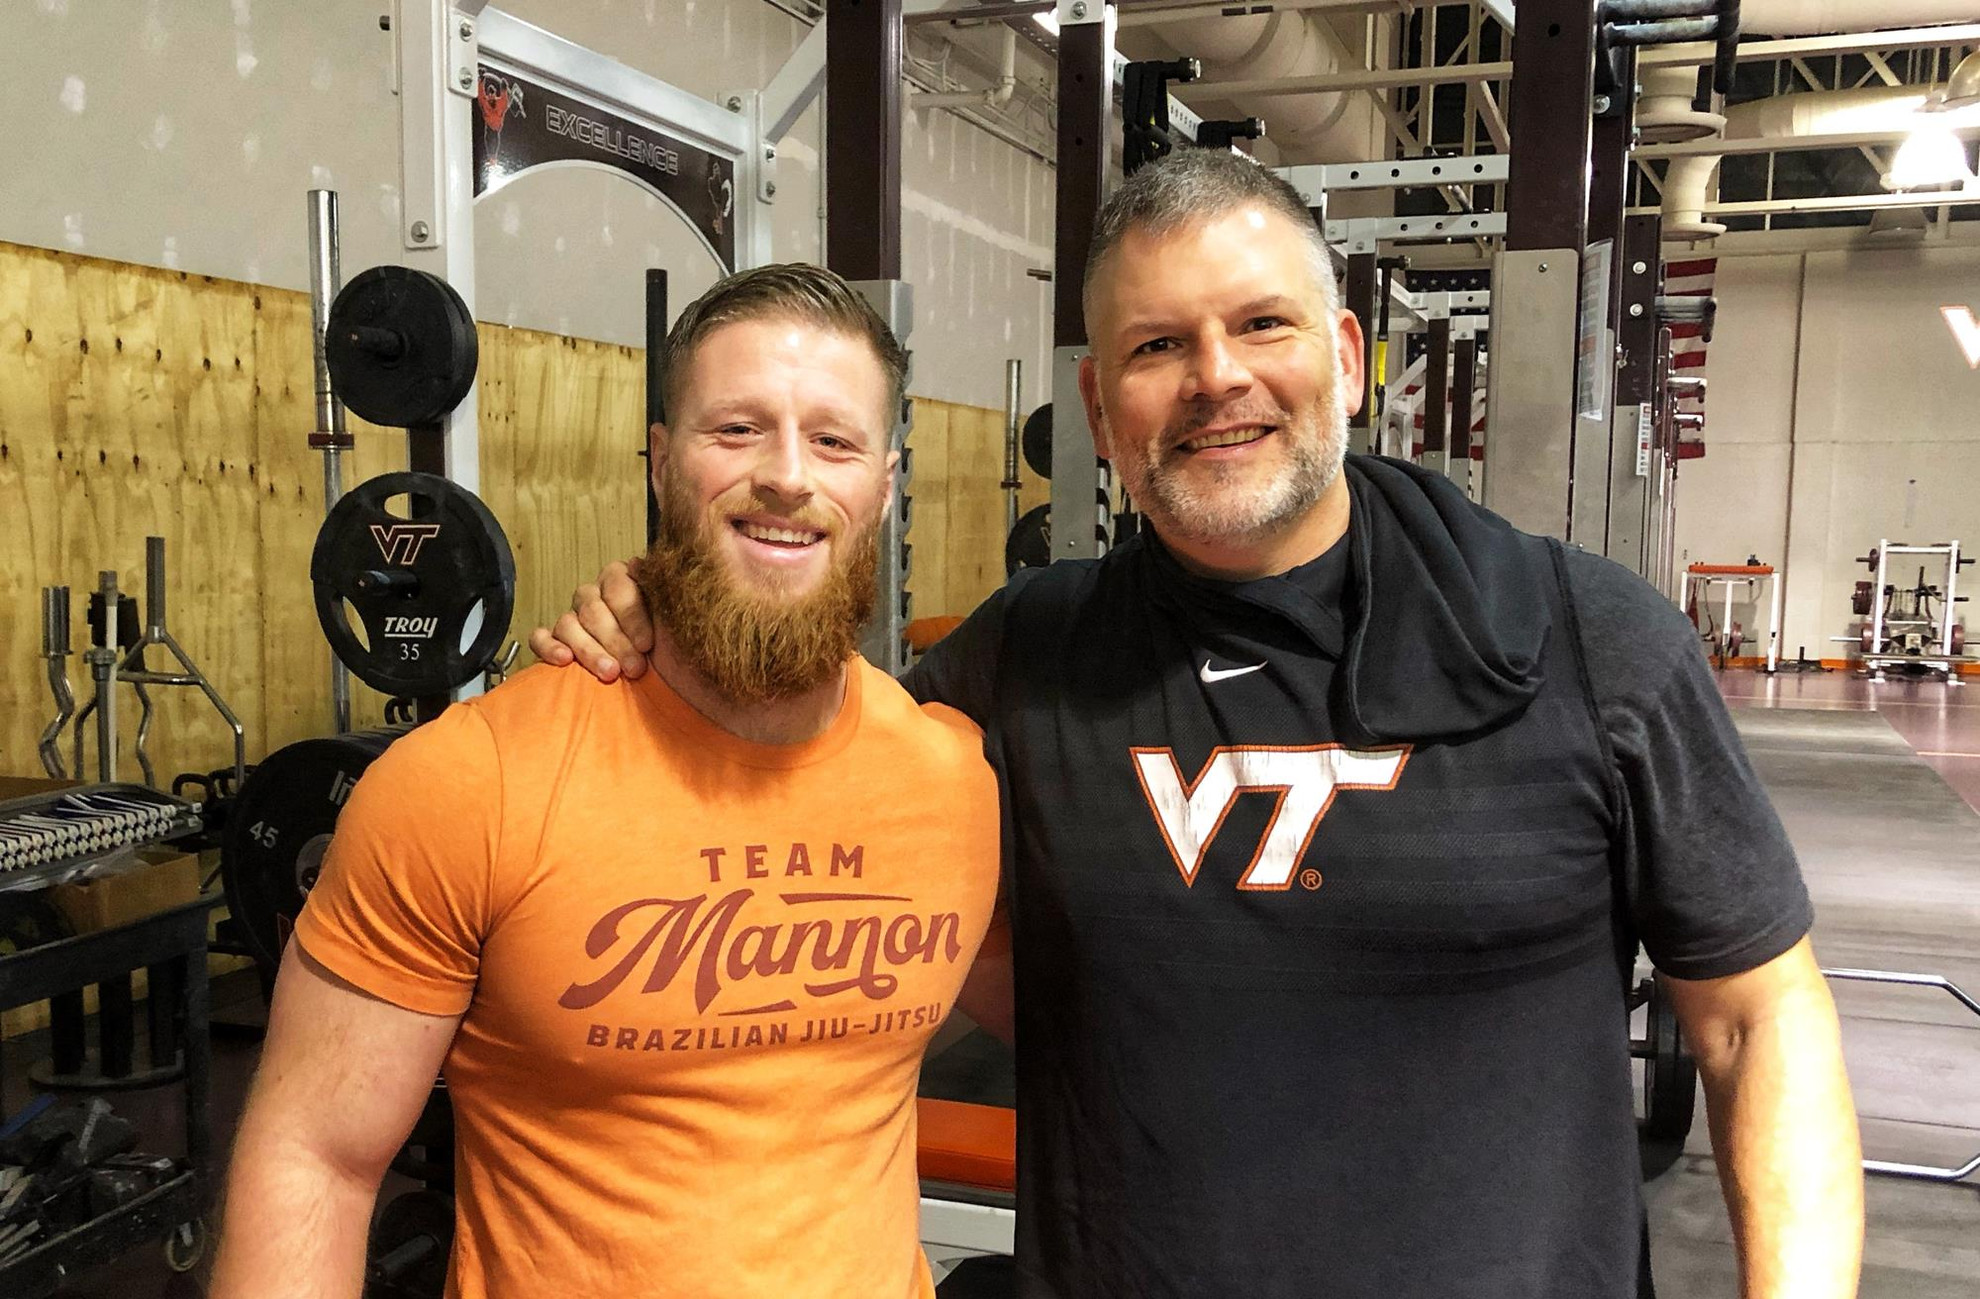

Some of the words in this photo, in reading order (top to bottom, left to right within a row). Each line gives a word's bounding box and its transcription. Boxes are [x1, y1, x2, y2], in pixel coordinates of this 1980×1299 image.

[545, 104, 679, 176] EXCELLENCE
[369, 524, 441, 566] VT
[384, 616, 438, 639] TROY
[399, 642, 421, 661] 35
[249, 810, 280, 849] 45
[1128, 742, 1415, 891] VT
[699, 842, 865, 882] TEAM
[558, 887, 962, 1016] Mannon
[586, 1022, 789, 1052] BRAZILIAN
[800, 1002, 942, 1042] JIU-JITSU
